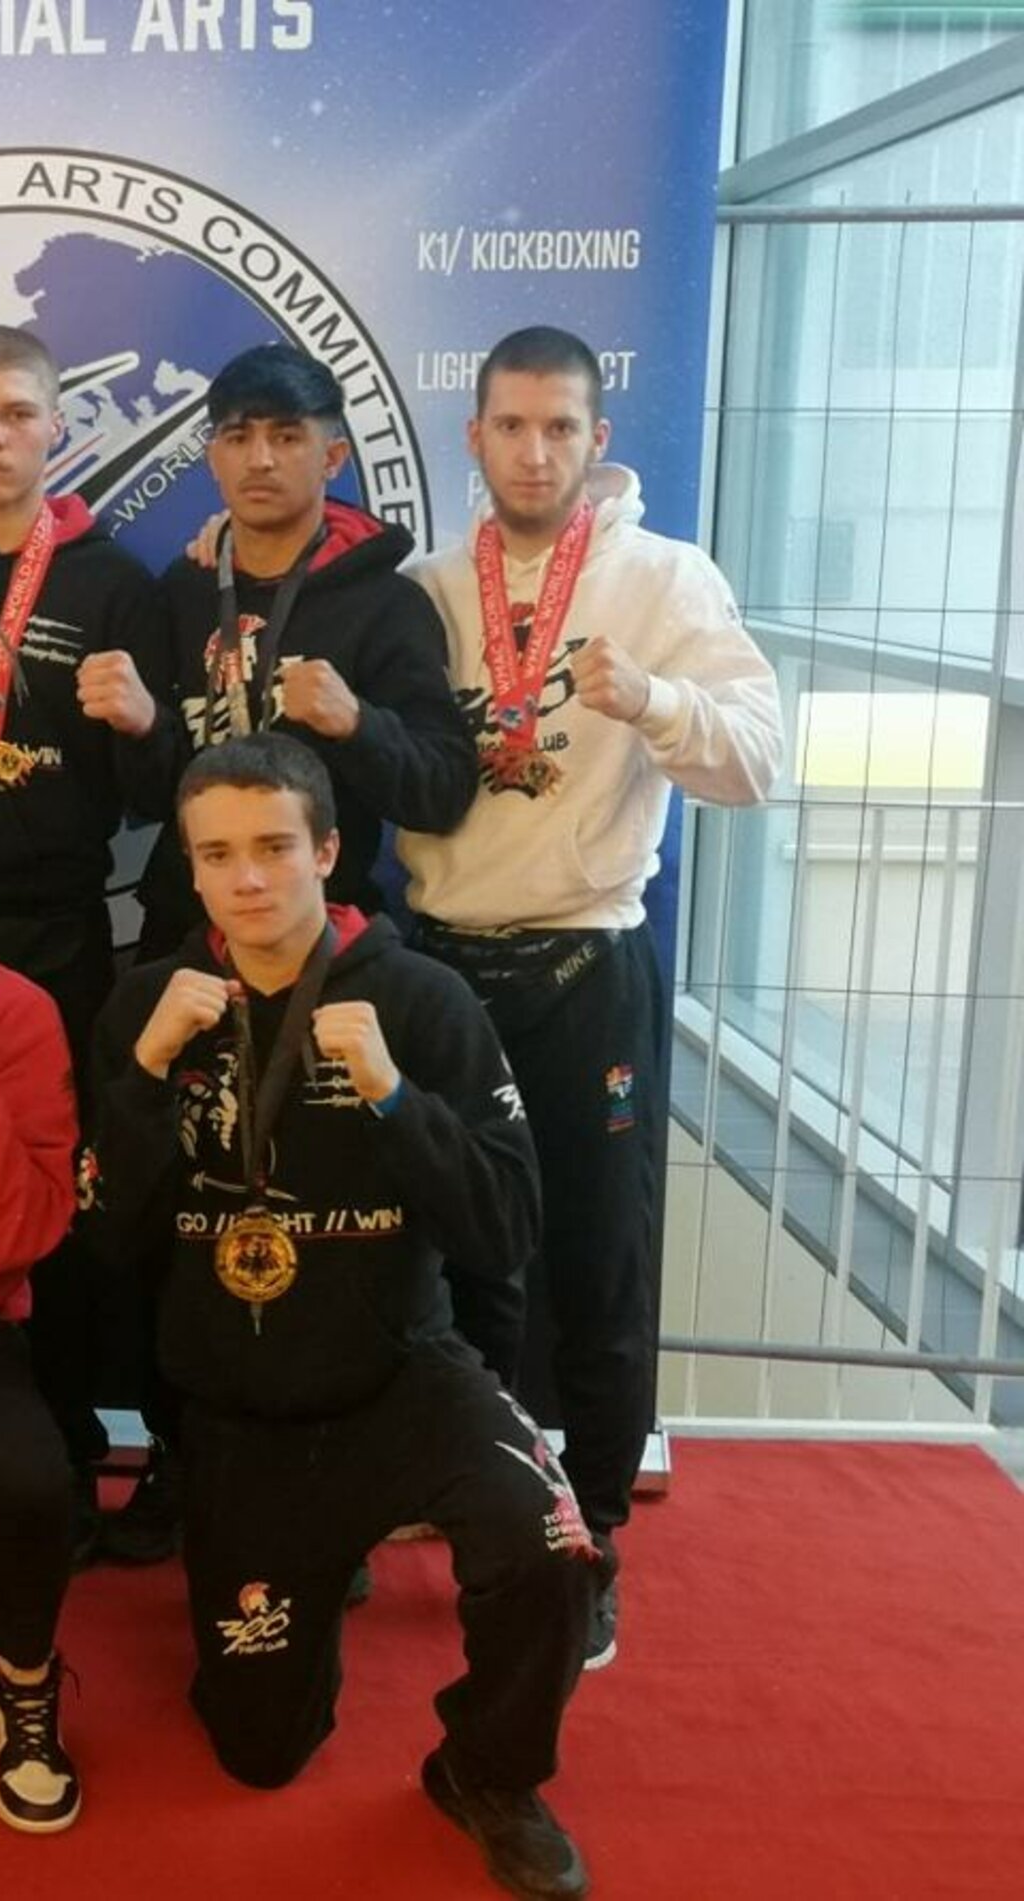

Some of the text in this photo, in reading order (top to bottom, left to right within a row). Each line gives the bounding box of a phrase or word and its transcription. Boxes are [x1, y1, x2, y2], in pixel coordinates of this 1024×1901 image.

[130, 0, 313, 52] ARTS
[417, 225, 642, 276] K1/ KICKBOXING
[17, 161, 184, 225] ARTS
[201, 215, 416, 533] COMMITTEE
[555, 939, 597, 986] NIKE
[176, 1212, 208, 1232] GO
[353, 1205, 403, 1231] WIN
